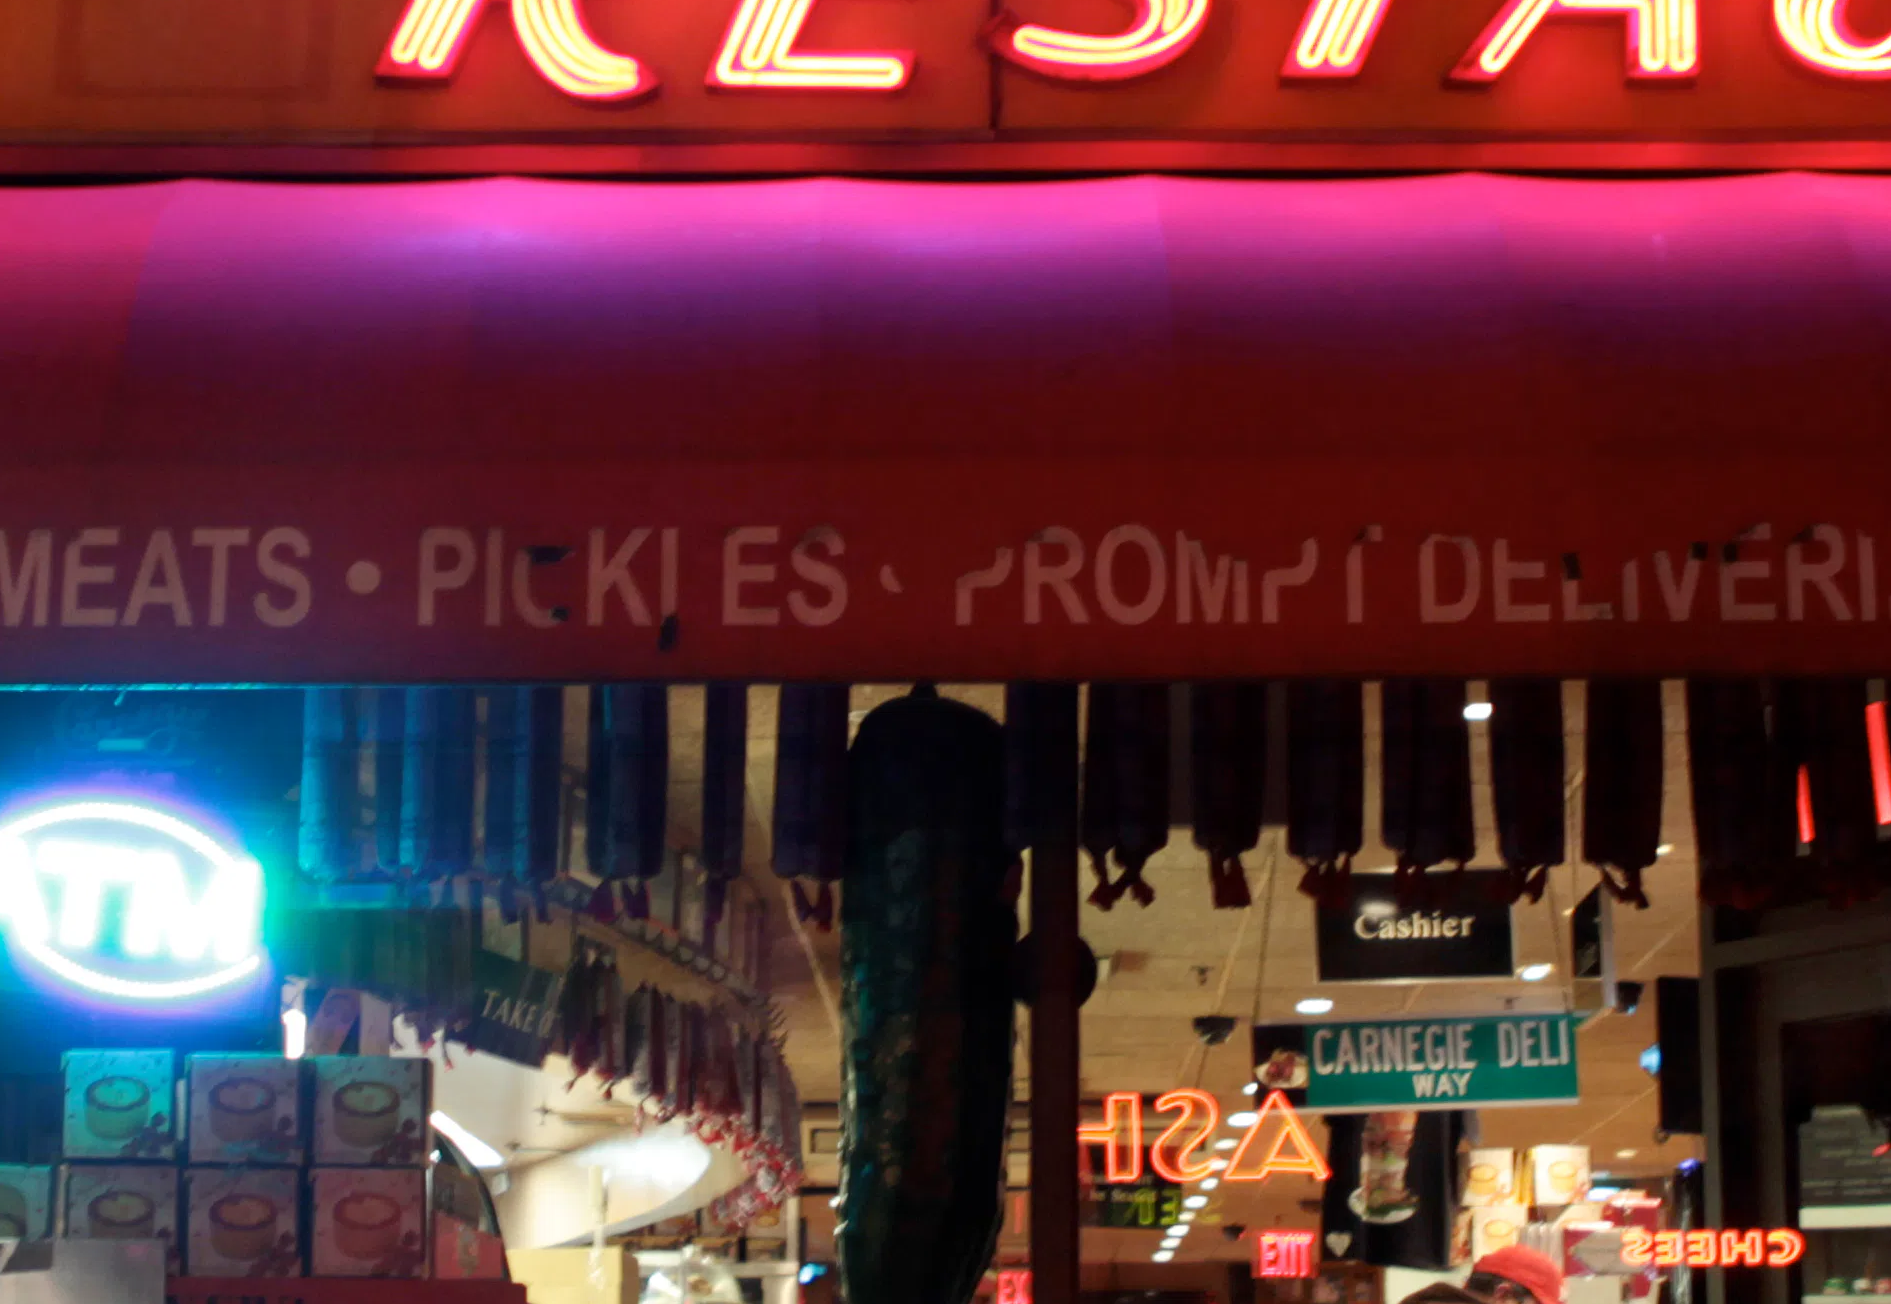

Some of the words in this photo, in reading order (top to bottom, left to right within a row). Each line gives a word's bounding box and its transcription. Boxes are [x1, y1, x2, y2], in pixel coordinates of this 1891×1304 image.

[1354, 909, 1474, 941] Cashier
[480, 987, 541, 1034] TAKE
[1312, 1020, 1477, 1076] CARNEGIE
[1497, 1012, 1572, 1069] DELI
[1411, 1071, 1472, 1099] WAY
[1259, 1232, 1314, 1277] EXIT
